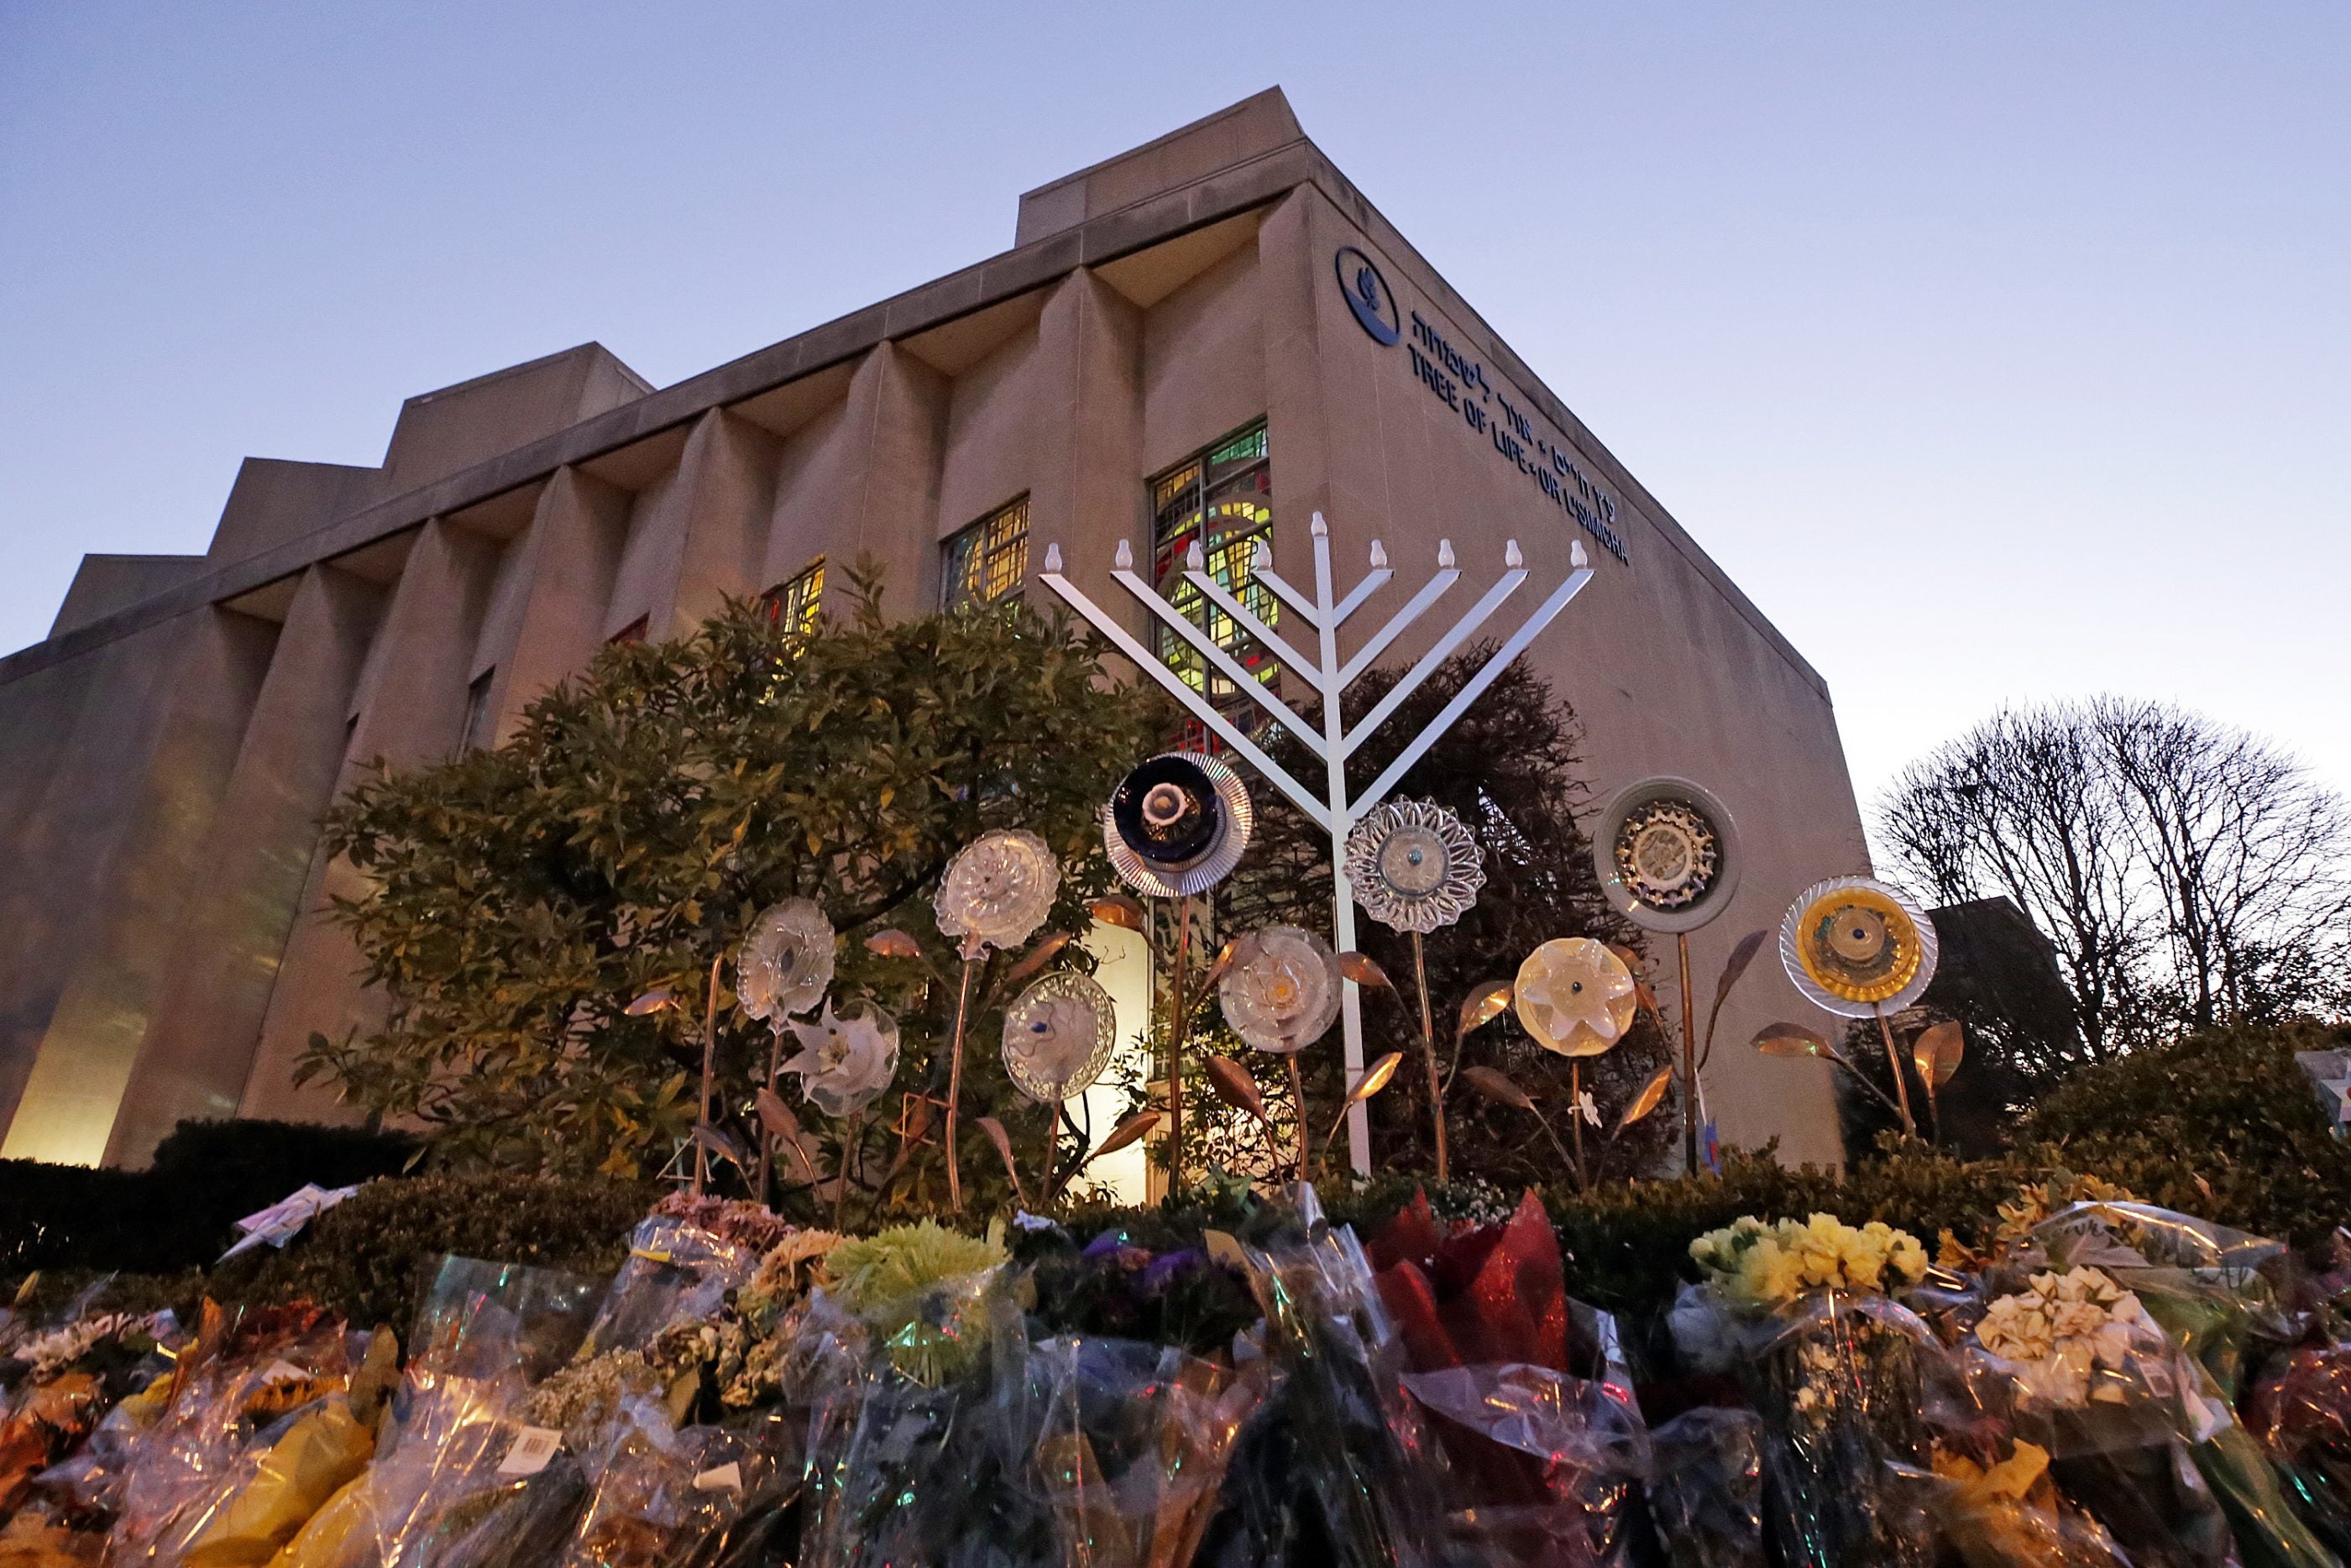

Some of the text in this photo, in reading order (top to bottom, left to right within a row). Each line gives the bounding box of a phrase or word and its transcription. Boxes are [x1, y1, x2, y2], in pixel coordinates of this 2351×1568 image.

[1411, 310, 1491, 403] לשמחה
[1407, 343, 1629, 567] TREE OF LIFE OR L'SIMCHA
[1497, 392, 1533, 447] אור
[1551, 445, 1590, 499] חיים
